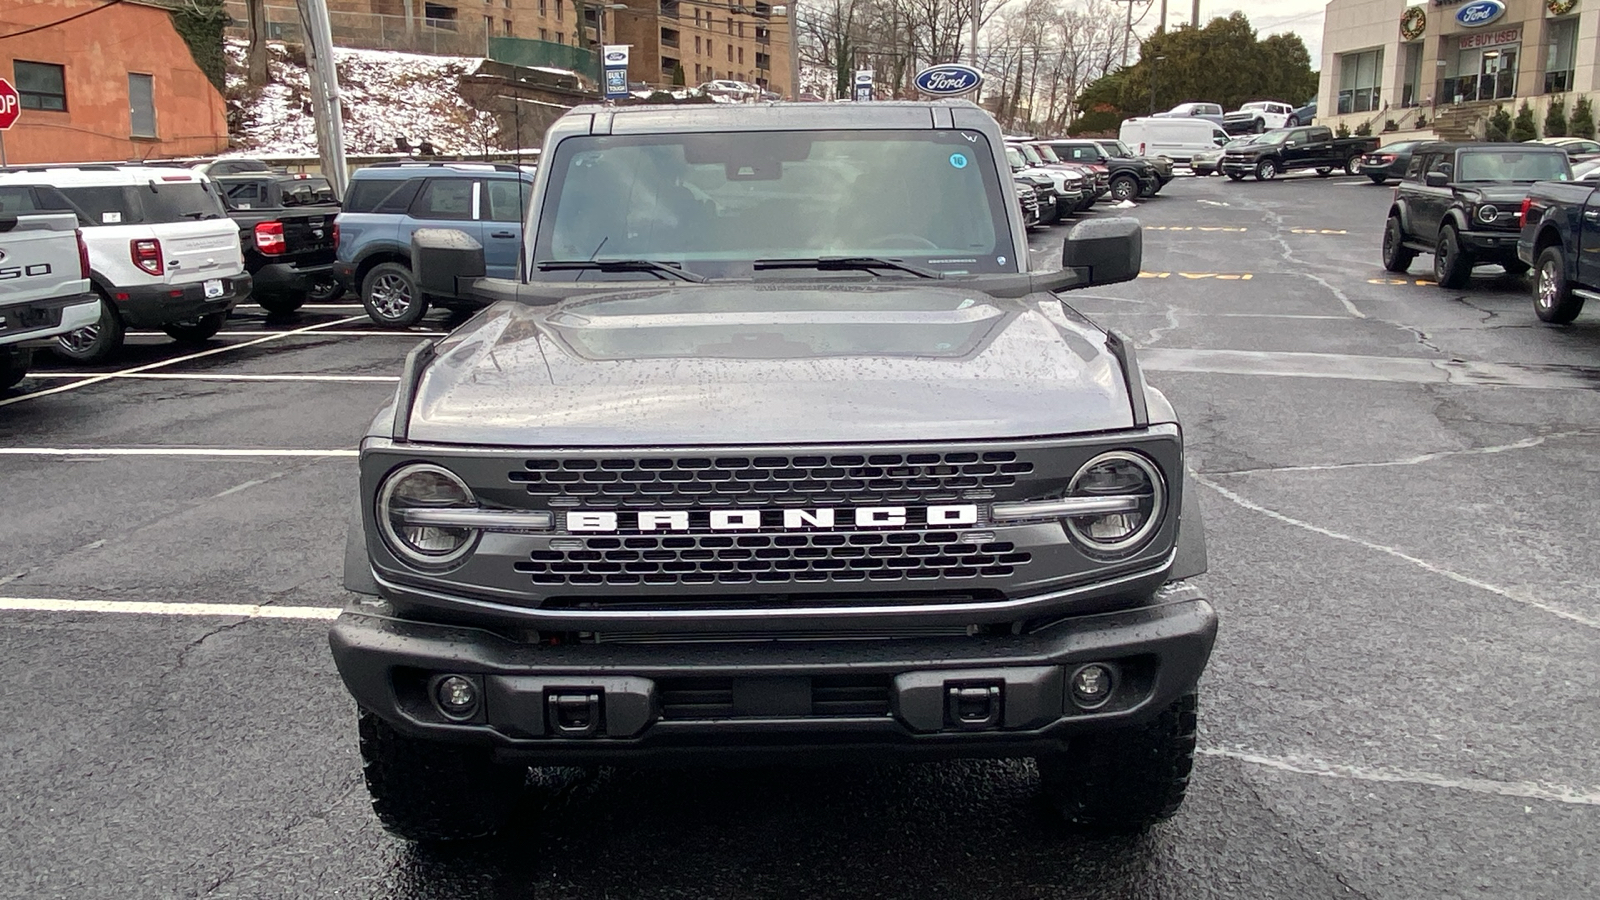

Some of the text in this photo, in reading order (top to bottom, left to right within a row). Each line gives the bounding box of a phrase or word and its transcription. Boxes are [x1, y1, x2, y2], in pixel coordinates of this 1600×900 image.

[1463, 6, 1491, 22] Ford
[1460, 36, 1474, 47] WE
[1475, 34, 1492, 45] BUY
[1494, 30, 1518, 43] USED
[926, 71, 966, 89] Ford
[952, 156, 964, 166] 16
[566, 504, 978, 531] BRONCO
